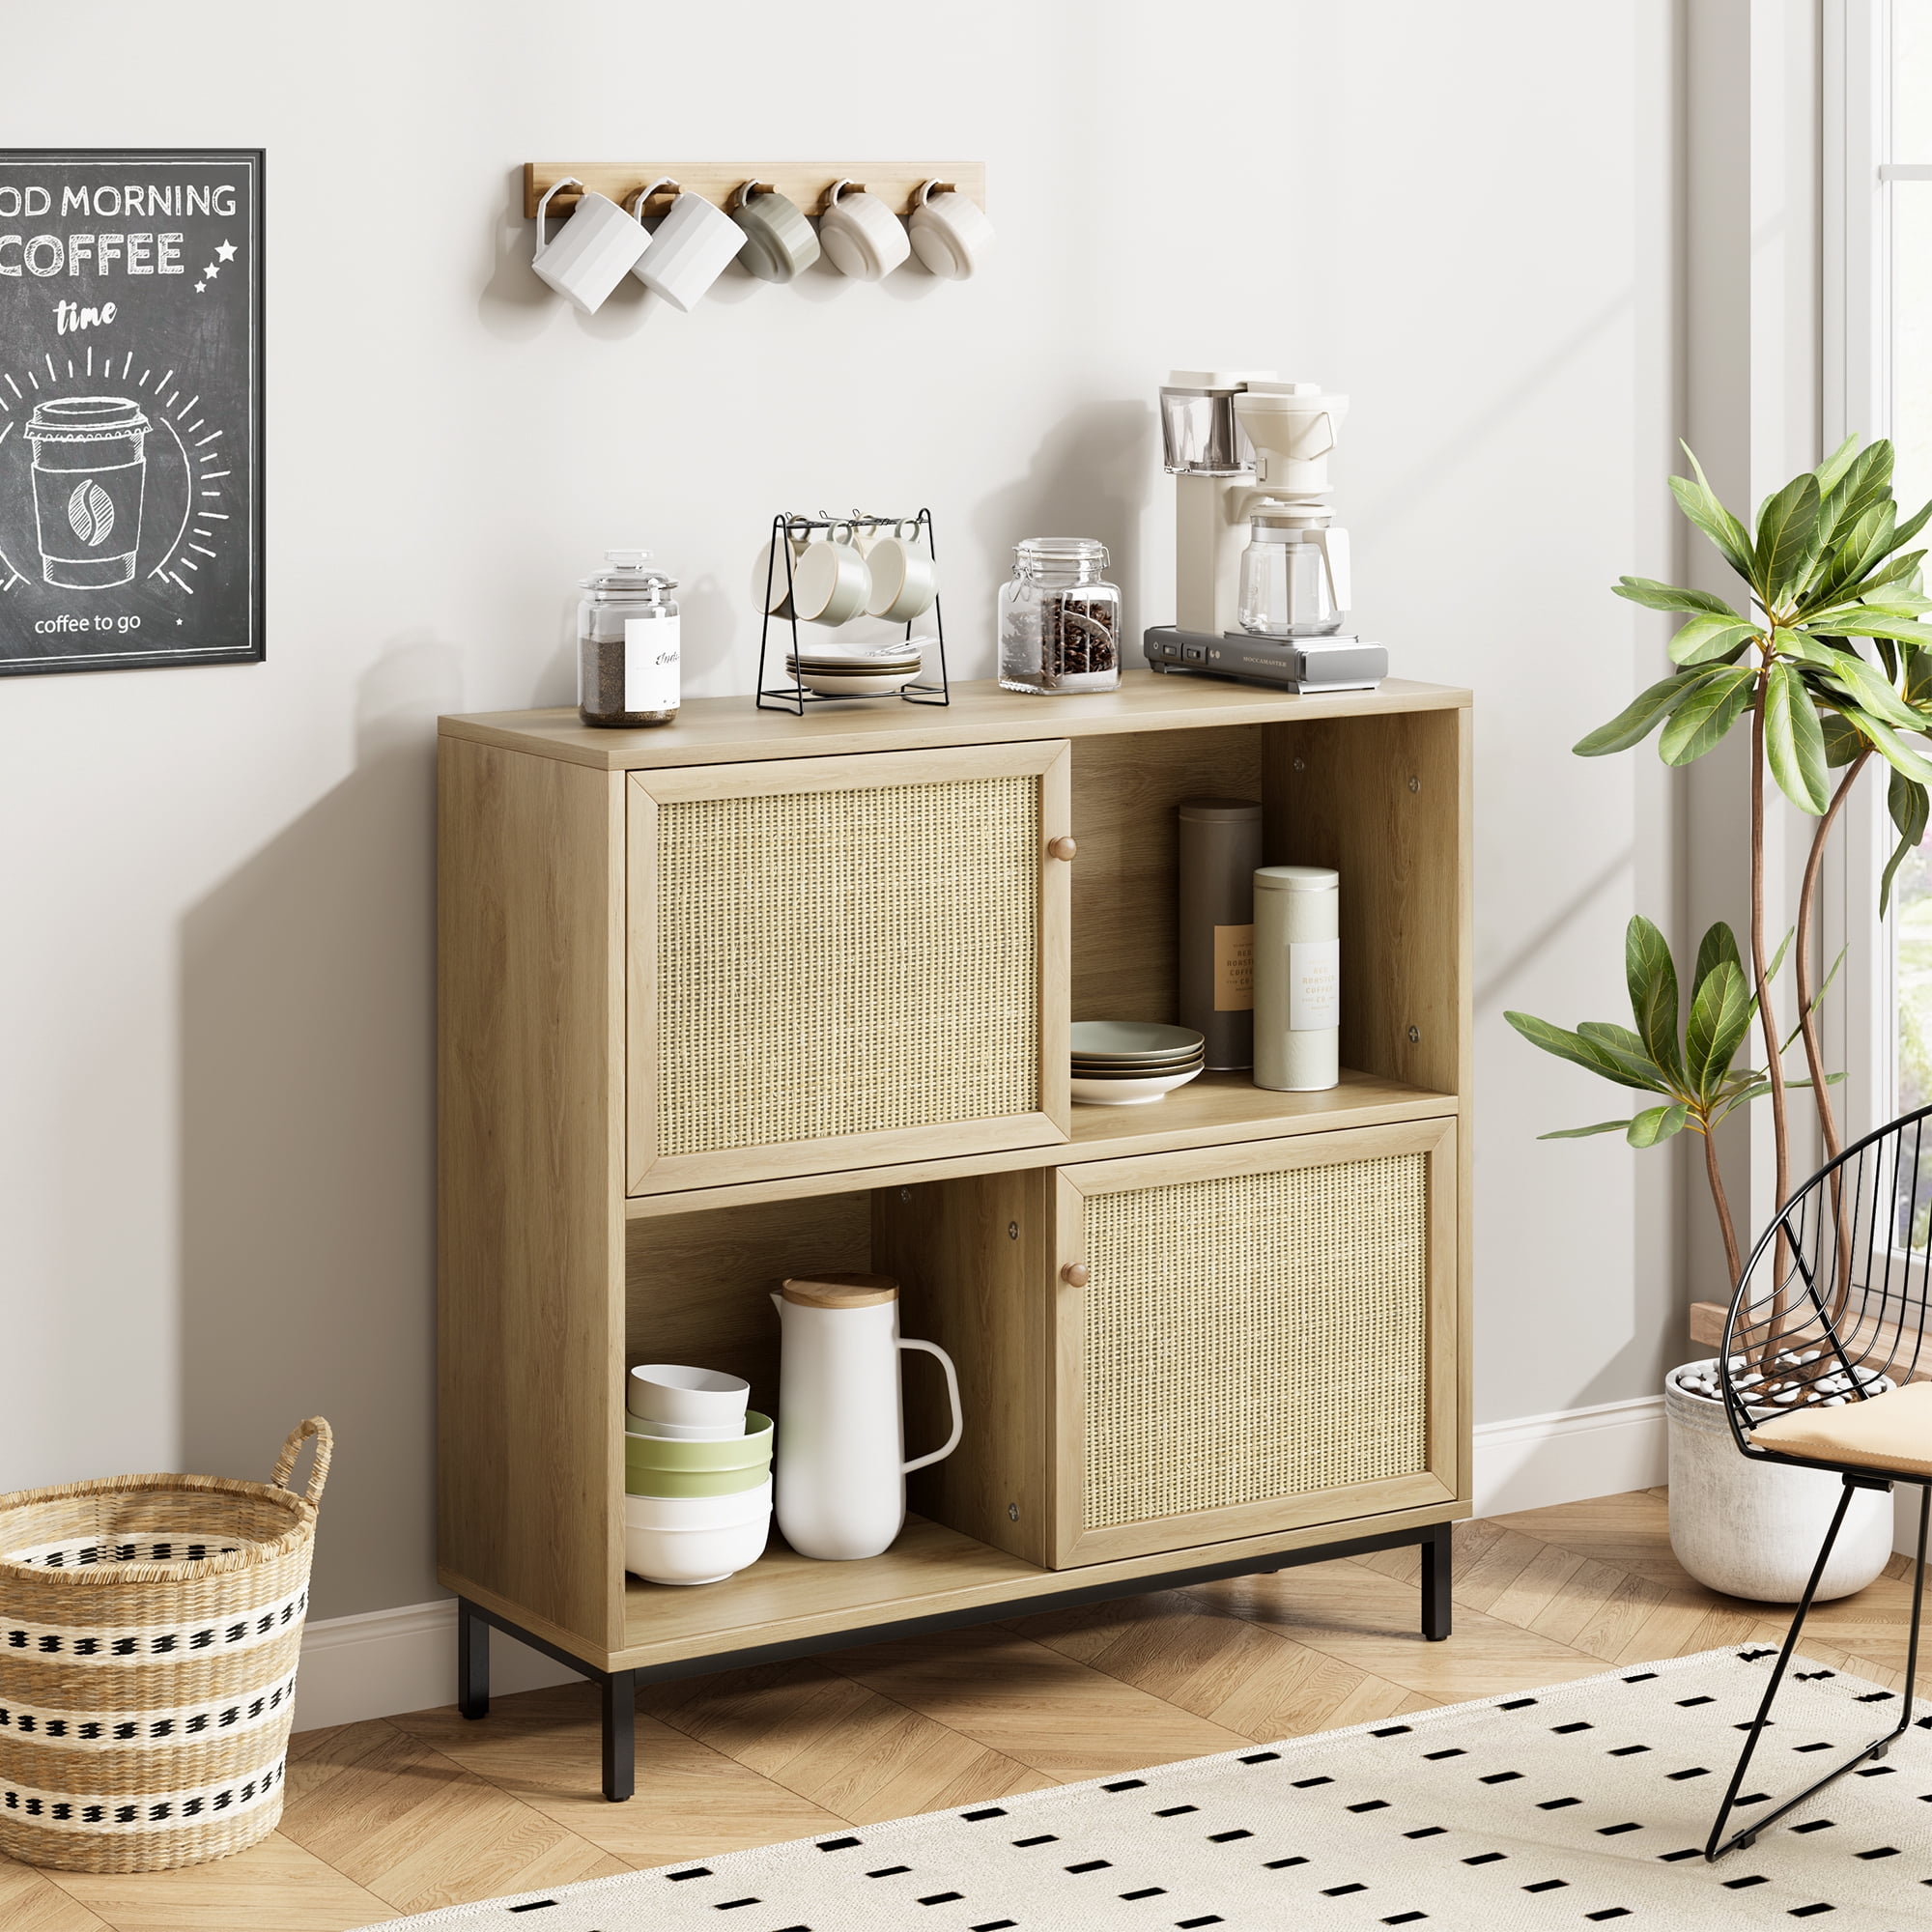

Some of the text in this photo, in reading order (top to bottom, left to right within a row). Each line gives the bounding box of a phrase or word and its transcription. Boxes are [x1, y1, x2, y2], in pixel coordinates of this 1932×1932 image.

[61, 185, 236, 216] MORNING
[0, 233, 185, 277] COFFEE
[53, 299, 118, 335] time
[35, 614, 141, 634] coffee to go
